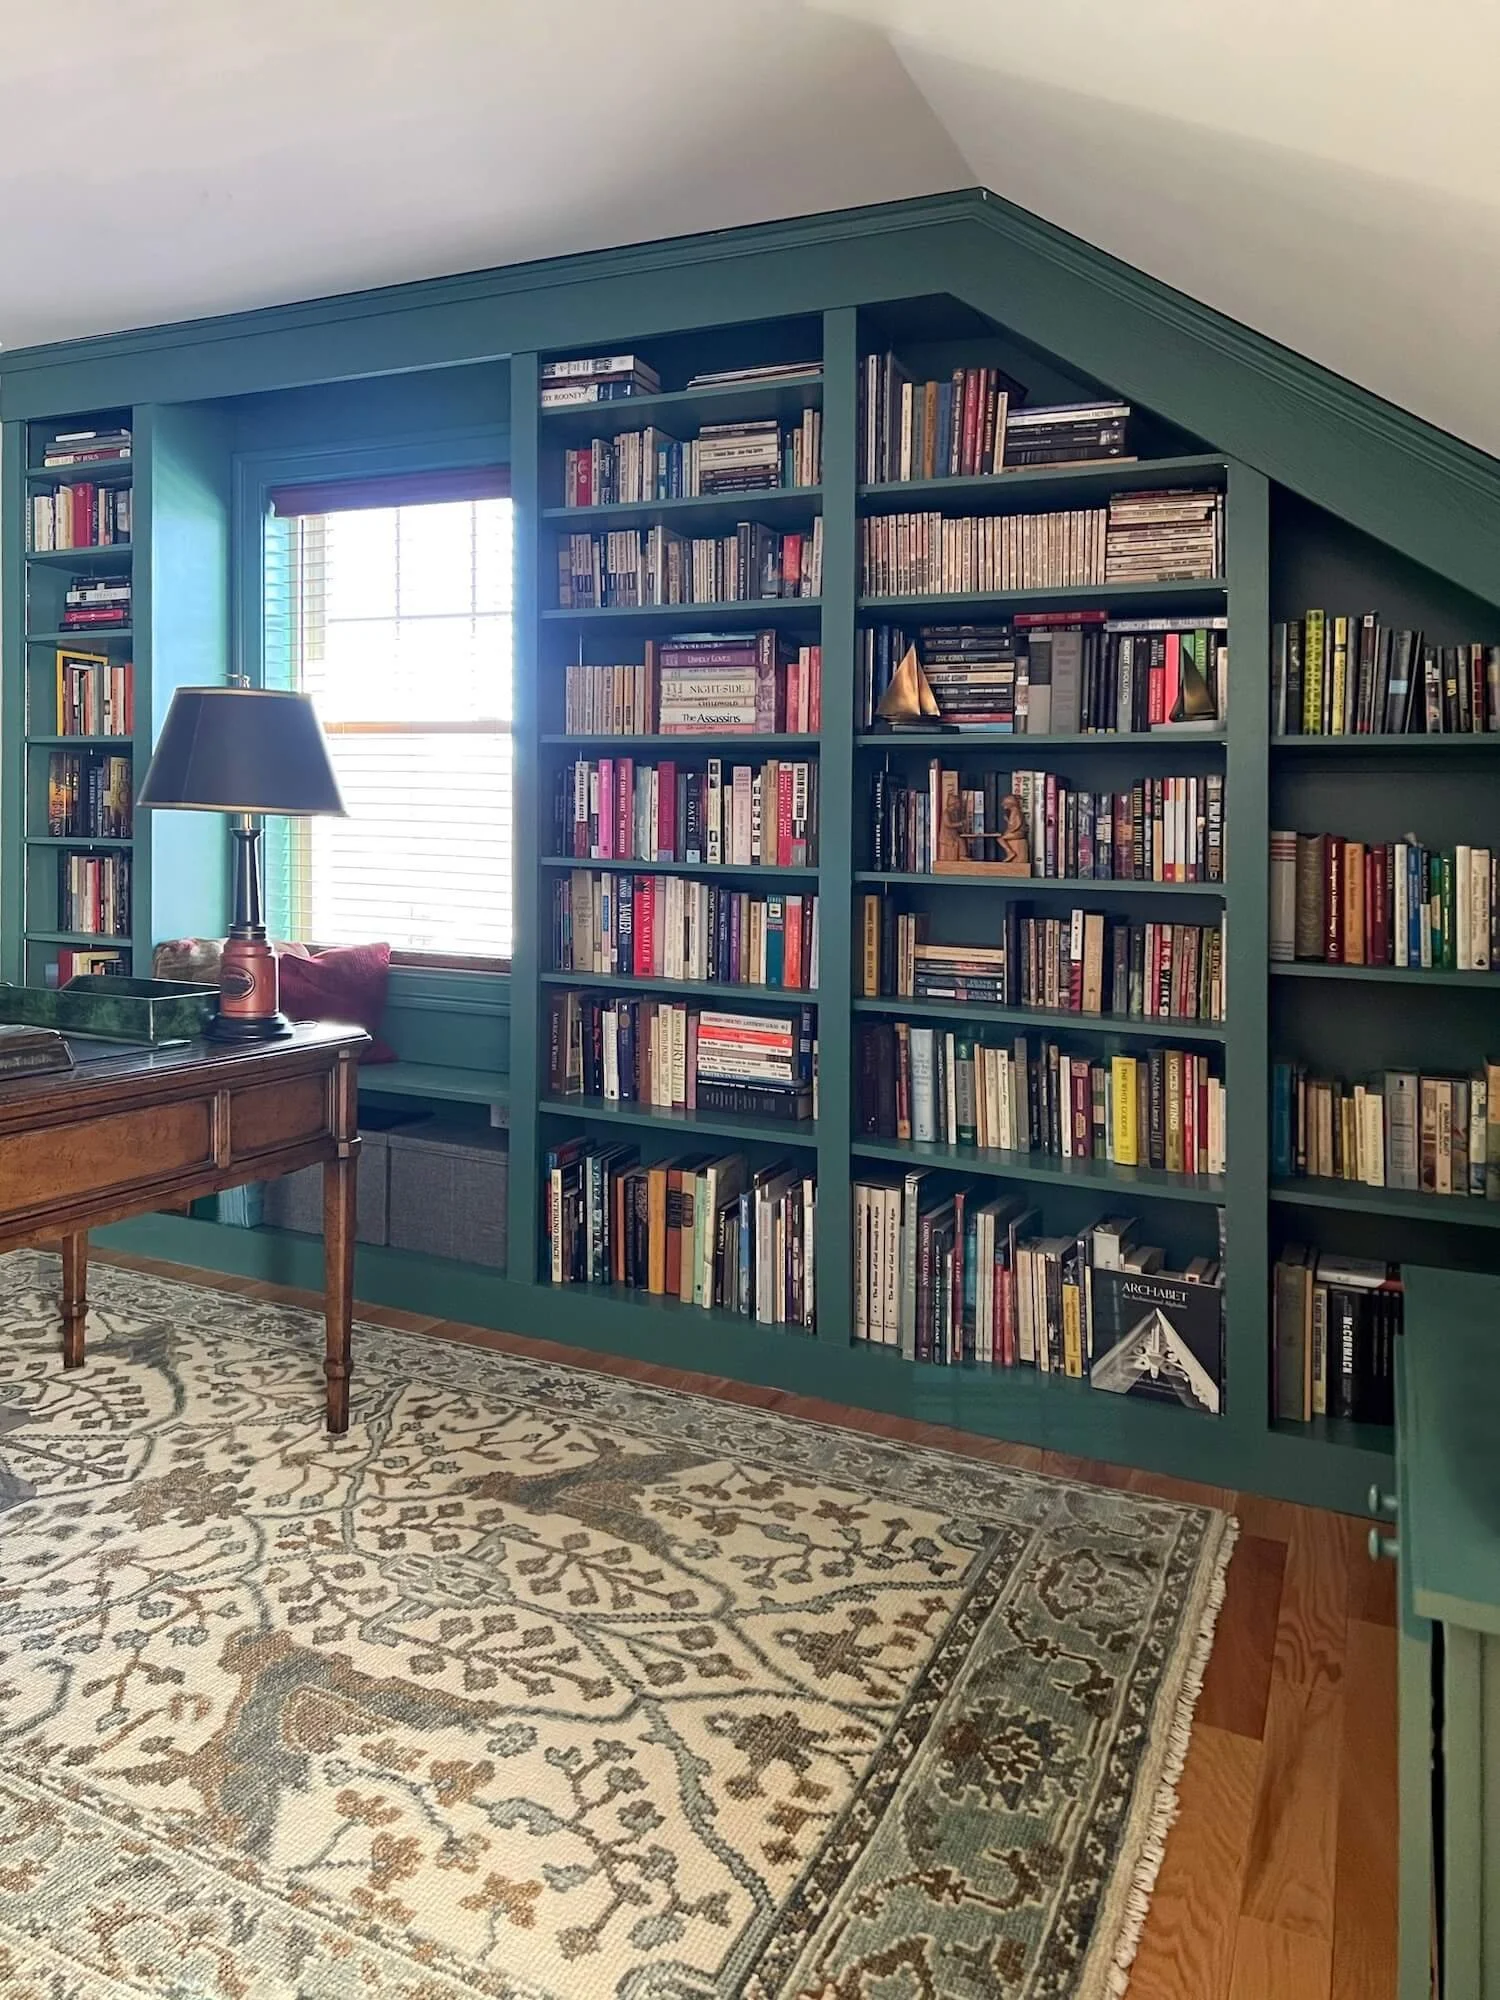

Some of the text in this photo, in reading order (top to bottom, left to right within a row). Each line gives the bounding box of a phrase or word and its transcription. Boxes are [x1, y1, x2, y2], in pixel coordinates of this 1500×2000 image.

[698, 712, 741, 724] Assassins
[1023, 777, 1031, 810] Arthur
[688, 801, 696, 833] OATES
[1170, 1058, 1180, 1131] VOICES WINDS
[1121, 1282, 1188, 1302] ARCHABET
[1342, 1316, 1352, 1374] McCORMACK
